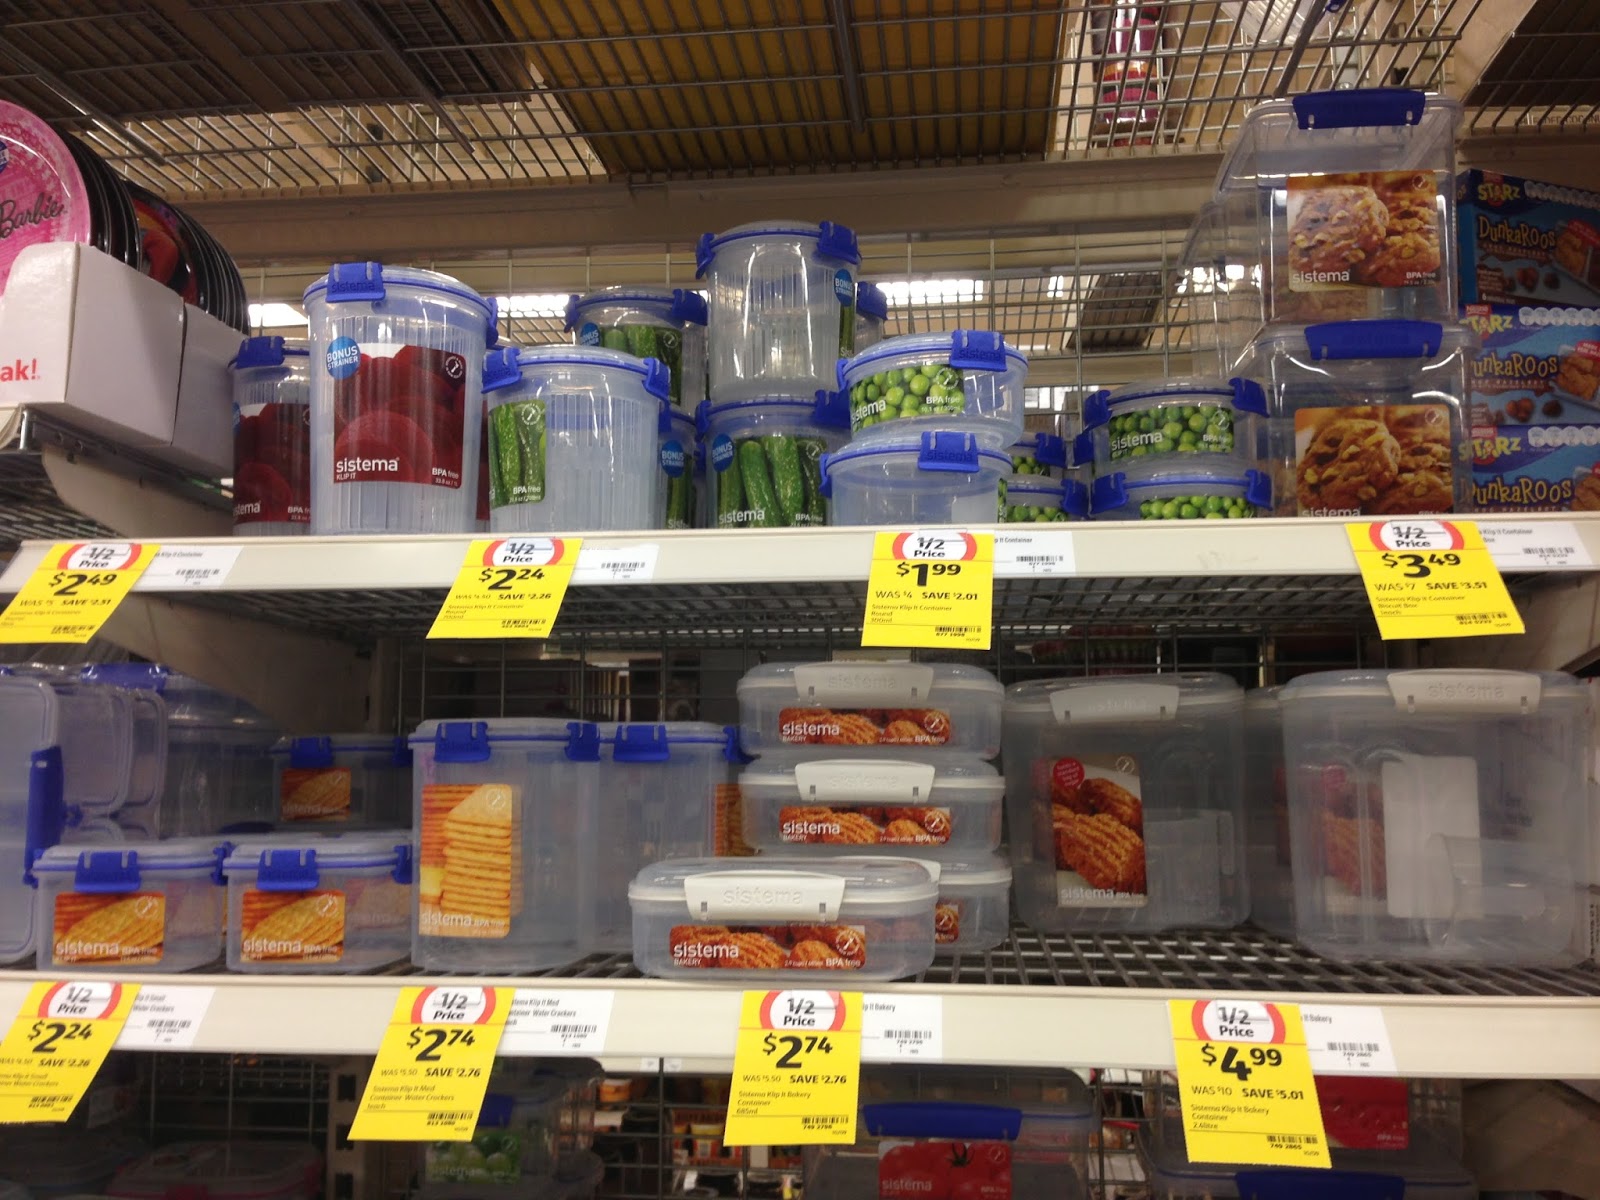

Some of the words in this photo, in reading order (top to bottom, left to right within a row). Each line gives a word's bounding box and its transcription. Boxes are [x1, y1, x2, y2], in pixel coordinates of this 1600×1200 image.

[0, 196, 64, 239] Barbie
[1292, 270, 1350, 283] sistema
[332, 281, 375, 293] sistema
[326, 346, 358, 363] BONUS
[327, 356, 359, 370] STRAINER
[852, 399, 887, 424] sistema
[926, 396, 944, 404] BPA
[1111, 431, 1163, 450] sistema
[661, 451, 684, 461] BONUS
[927, 450, 972, 461] sistema
[336, 457, 398, 474] sistema
[431, 467, 447, 477] BPA
[448, 469, 459, 479] free
[336, 472, 349, 480] KLIP
[350, 472, 356, 480] IT
[513, 487, 526, 495] BPA
[528, 485, 541, 494] free
[287, 505, 303, 514] BPA
[719, 509, 765, 524] sistema
[796, 513, 809, 521] BPA
[1392, 526, 1426, 539] 1/2
[509, 542, 535, 555] 1/2
[917, 537, 945, 550] 1/2
[1396, 540, 1431, 548] Price
[88, 547, 114, 560] 1/2
[914, 550, 945, 558] Price
[79, 560, 110, 568] Price
[1426, 582, 1459, 590] SAVE
[1460, 581, 1487, 589] $3.51
[875, 591, 901, 599] WAS
[1428, 681, 1504, 699] sistema
[782, 721, 840, 736] sistema
[782, 820, 840, 835] sistema
[723, 885, 803, 906] sistema
[1060, 887, 1114, 900] sistema
[421, 913, 472, 926] sistema
[56, 939, 119, 955] sistema
[243, 937, 301, 953] sistema
[674, 942, 740, 958] sistema
[674, 958, 702, 966] BAKERY
[825, 958, 844, 967] BPA
[845, 959, 861, 967] free
[66, 986, 93, 1003] 1/2
[441, 993, 468, 1009] 1/2
[57, 1003, 88, 1014] Price
[787, 998, 815, 1015] 1/2
[874, 1003, 896, 1012] Bakery
[433, 1011, 465, 1020] Price
[783, 1015, 815, 1026] Price
[1218, 1006, 1251, 1024] 1/2
[1219, 1025, 1254, 1037] Price
[39, 1058, 65, 1067] SAVE
[425, 1068, 454, 1077] SAVE
[456, 1068, 481, 1077] $2.76
[790, 1075, 818, 1083] SAVE
[821, 1075, 847, 1084] $2.76
[1191, 1086, 1215, 1095] WAS
[1217, 1086, 1232, 1096] $10
[1242, 1088, 1274, 1099] SAVE
[1276, 1089, 1304, 1100] $5.01
[882, 1178, 932, 1192] sistema
